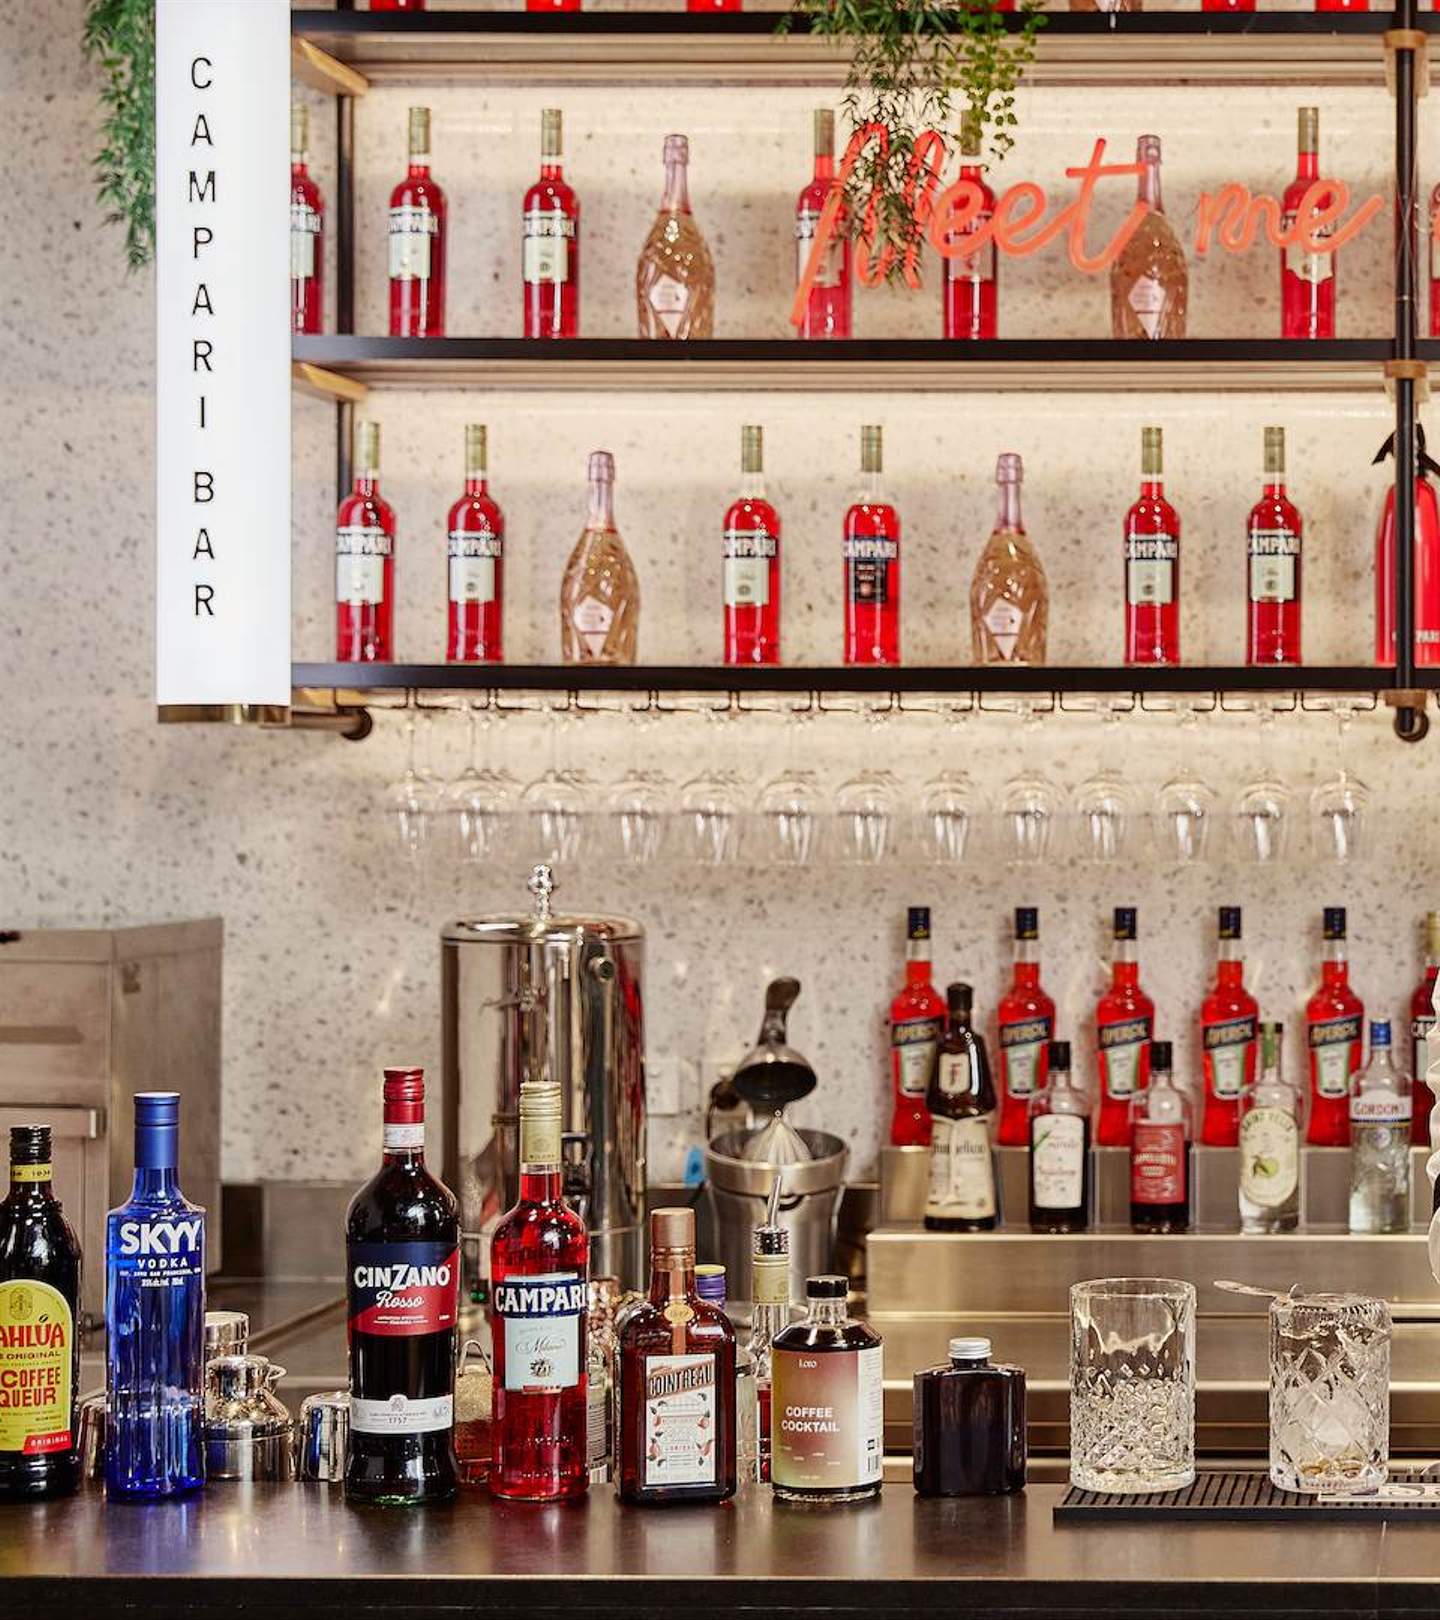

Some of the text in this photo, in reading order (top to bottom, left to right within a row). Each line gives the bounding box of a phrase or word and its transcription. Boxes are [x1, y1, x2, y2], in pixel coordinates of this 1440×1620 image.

[790, 121, 1151, 326] Meet
[1197, 179, 1385, 255] me
[188, 56, 217, 617] CAMPARI BAR
[119, 1219, 202, 1255] SKYY
[137, 1256, 188, 1270] VODKA
[353, 1263, 451, 1291] CINZANO
[375, 1289, 425, 1309] Rosso
[494, 1282, 588, 1313] CAMPARI
[0, 1313, 65, 1349] AHLÚA
[7, 1350, 61, 1360] ORIGINAL
[1, 1366, 61, 1388] COFFEE
[649, 1361, 715, 1398] COINTREAU
[0, 1387, 56, 1408] QUEUR
[785, 1405, 834, 1418] COFFEE
[781, 1419, 841, 1433] COCKTAIL
